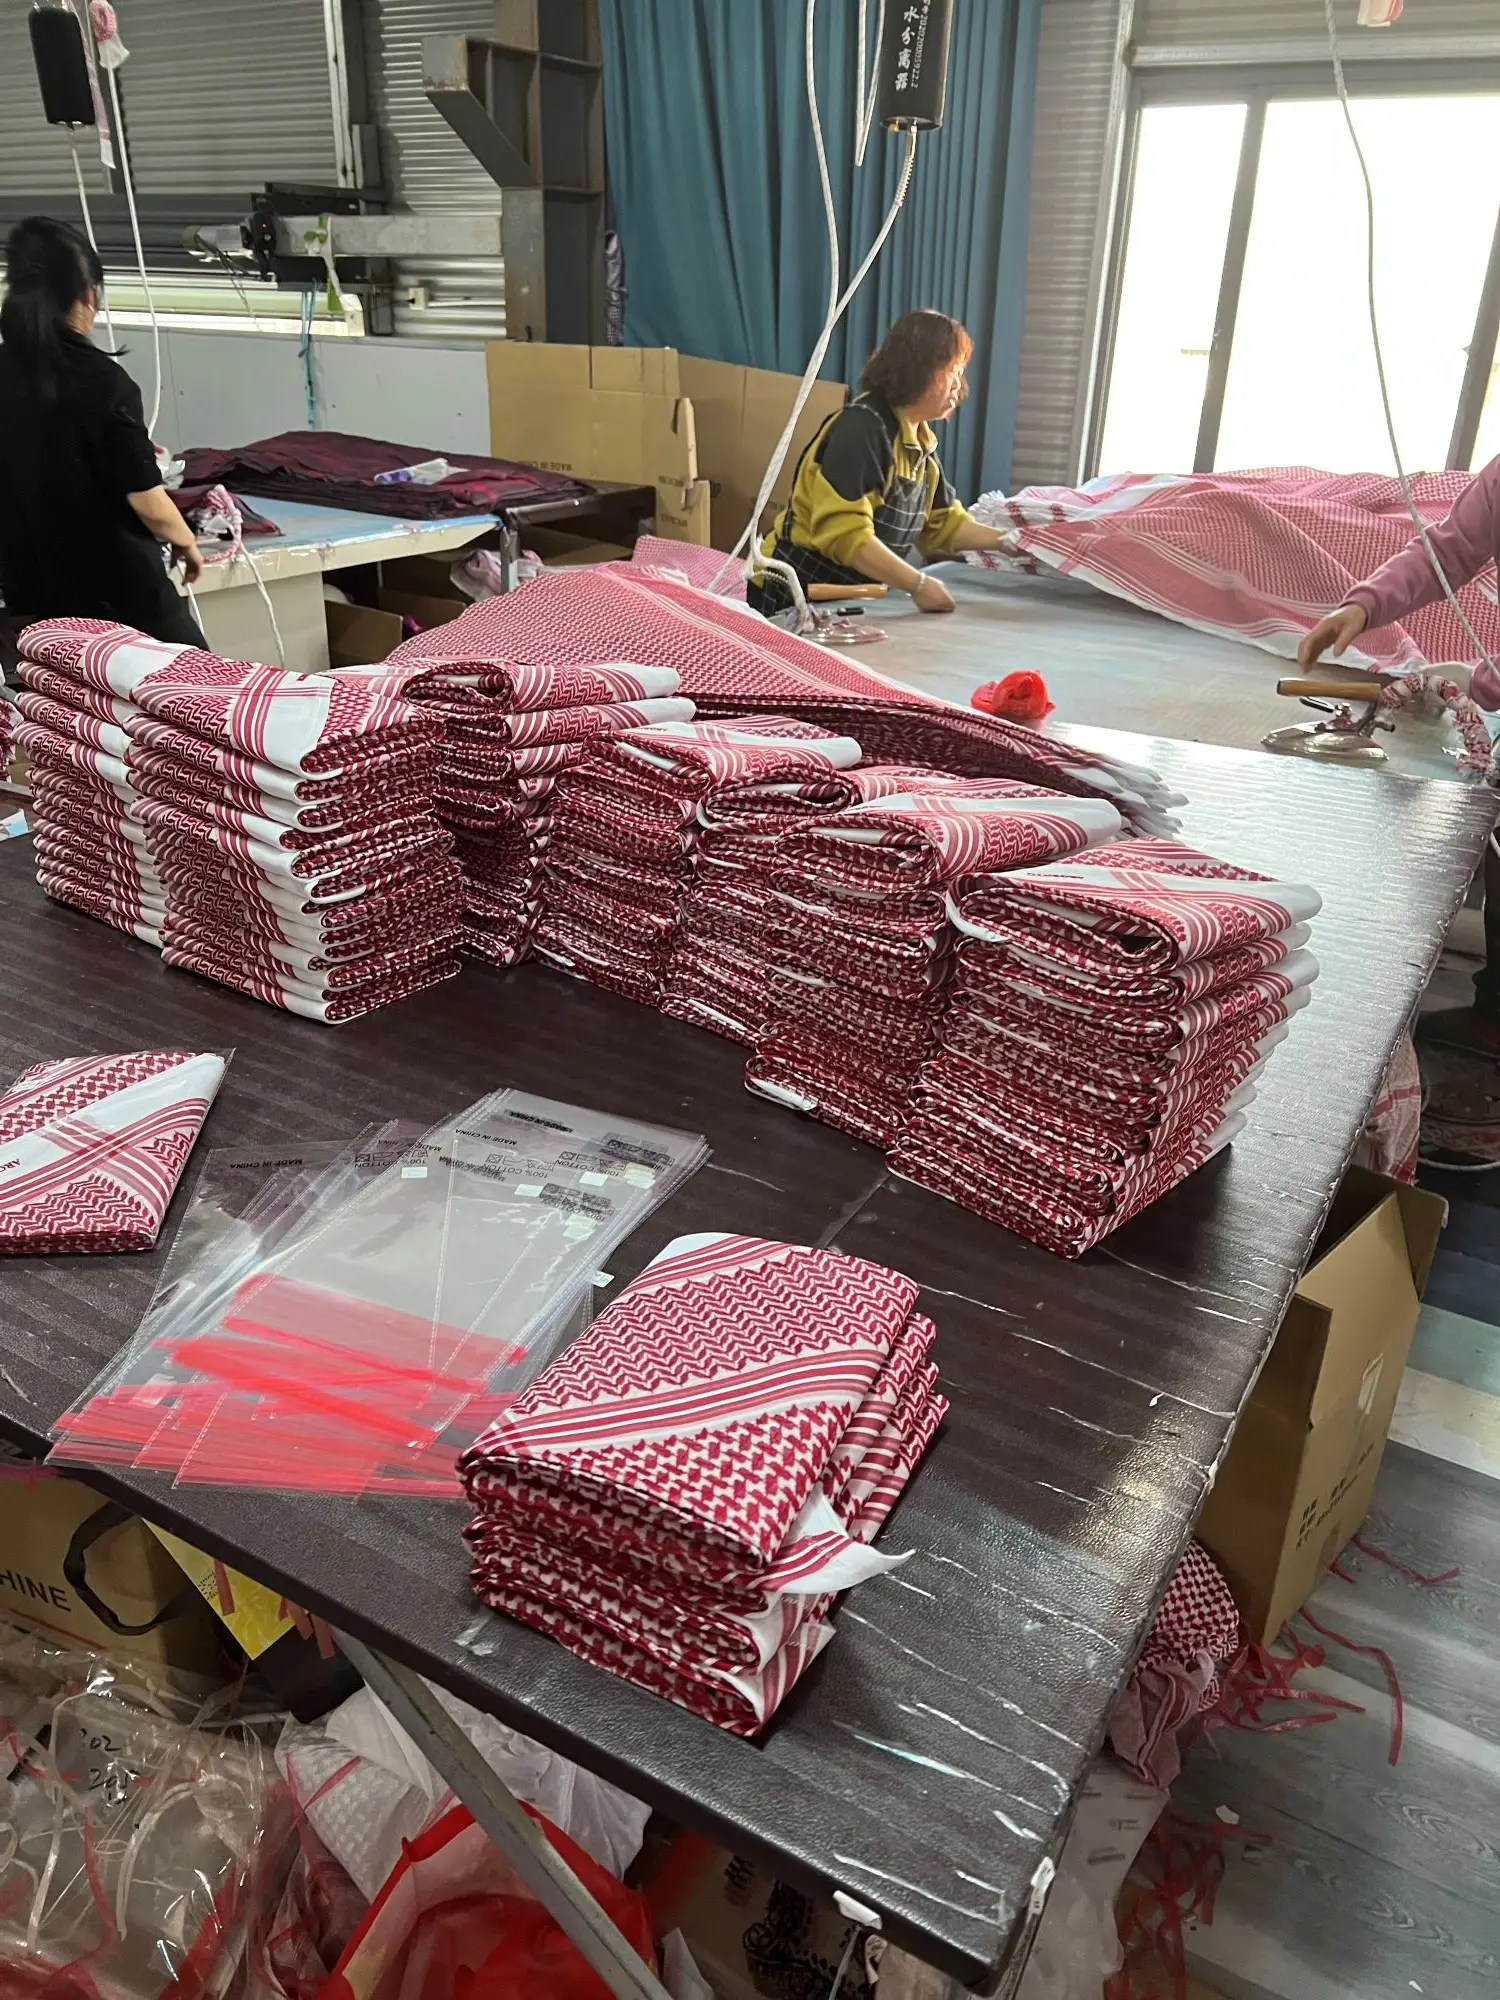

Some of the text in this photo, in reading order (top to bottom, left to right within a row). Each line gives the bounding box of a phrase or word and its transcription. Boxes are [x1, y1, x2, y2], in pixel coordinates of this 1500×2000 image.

[455, 1129, 481, 1139] CHINA
[492, 1136, 518, 1146] MADE
[229, 1158, 303, 1170] MADE IN CHINA
[482, 1163, 523, 1175] COTTON
[554, 1159, 595, 1172] COTTON
[525, 1169, 548, 1179] 100%
